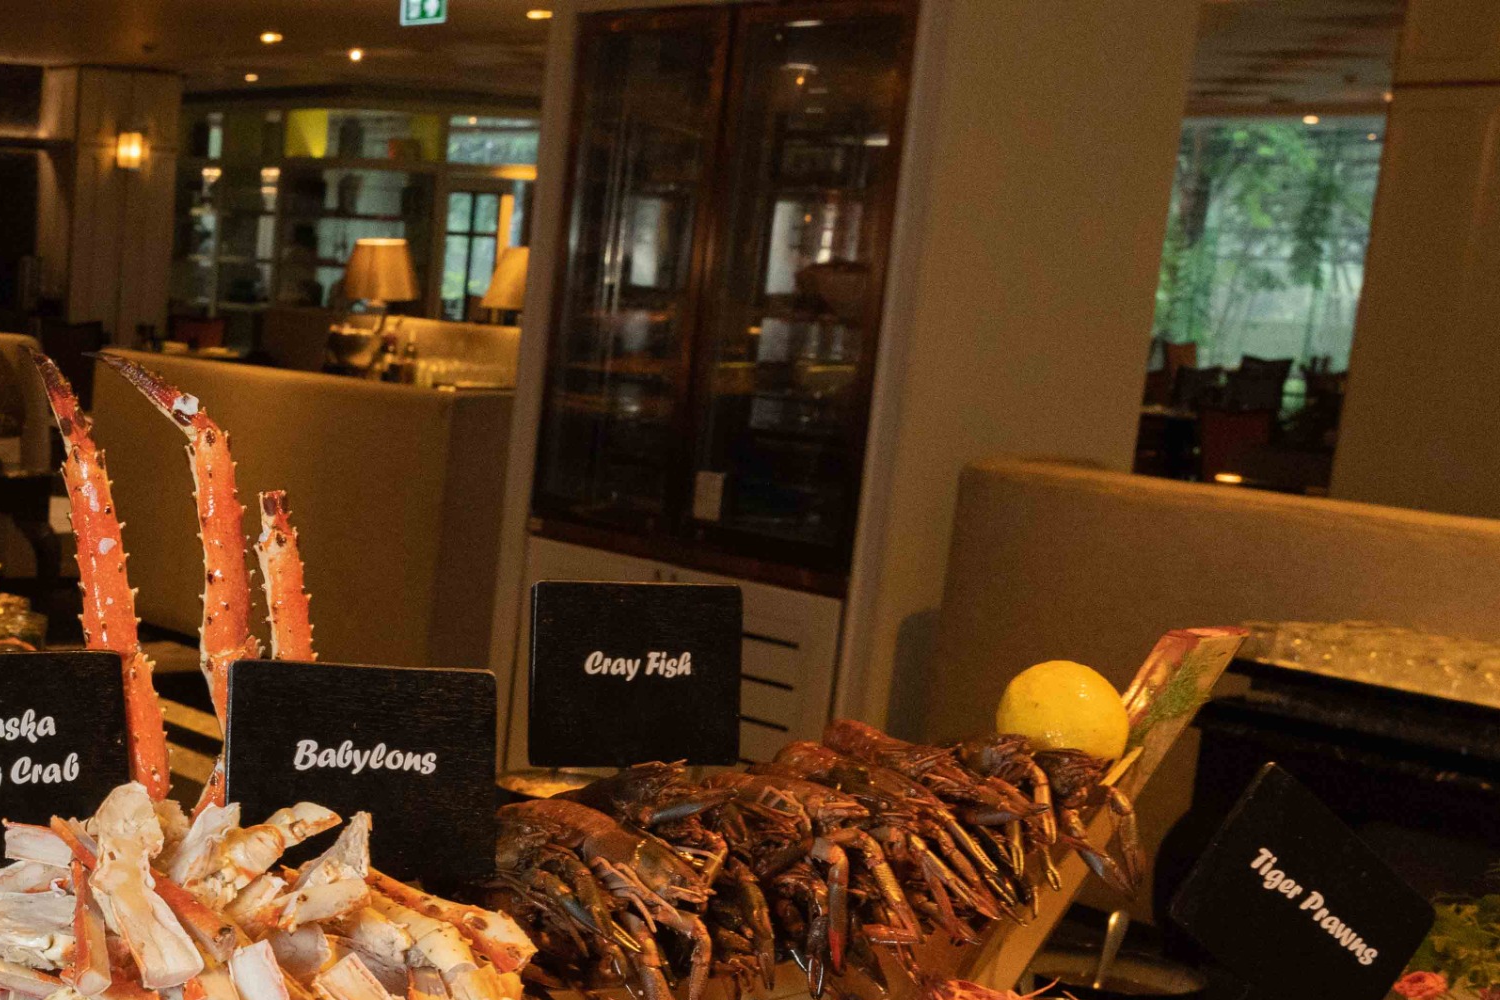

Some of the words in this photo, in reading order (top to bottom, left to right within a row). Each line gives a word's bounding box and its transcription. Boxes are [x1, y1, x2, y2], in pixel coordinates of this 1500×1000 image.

[584, 650, 641, 682] Cray
[645, 650, 692, 678] Fish
[10, 752, 80, 785] Crab
[293, 738, 438, 776] Babylons
[1249, 846, 1303, 900] Tiger
[1299, 890, 1379, 967] Prawns
